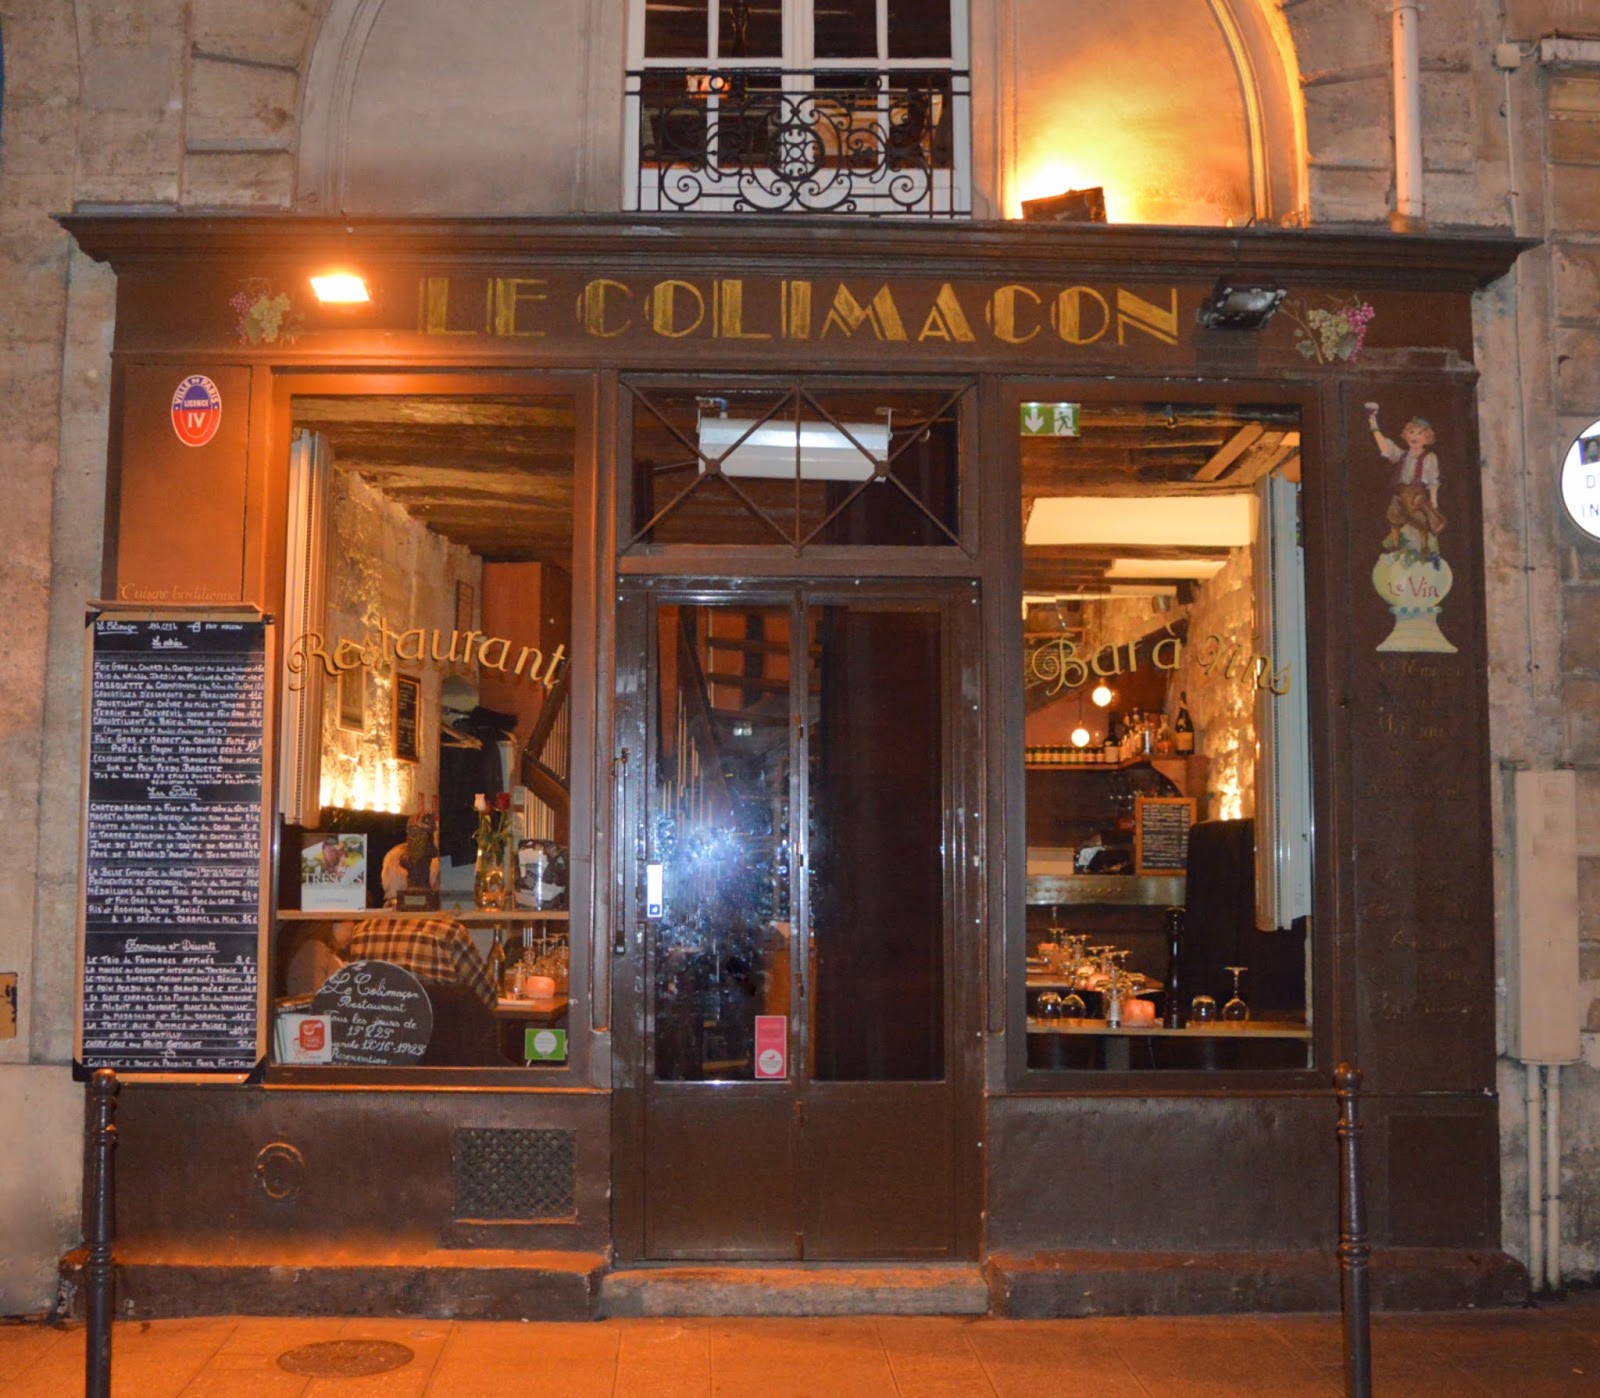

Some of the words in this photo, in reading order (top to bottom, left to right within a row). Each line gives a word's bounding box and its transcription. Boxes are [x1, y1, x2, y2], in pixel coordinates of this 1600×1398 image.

[417, 277, 547, 336] LE
[173, 380, 192, 405] VILLE
[200, 379, 219, 404] PARIS
[188, 412, 206, 428] IV
[1388, 582, 1403, 597] Le
[1408, 575, 1439, 599] Vin
[287, 617, 565, 691] Restaurant
[1031, 633, 1142, 697] Bar
[1151, 624, 1182, 670] à
[1196, 633, 1291, 696] Vins
[94, 681, 144, 689] CASSOLETTE
[134, 955, 176, 964] FROMAGES
[353, 972, 421, 1001] Colimaçon
[337, 995, 406, 1013] Restaurant
[352, 1012, 367, 1025] les
[403, 1018, 418, 1029] de
